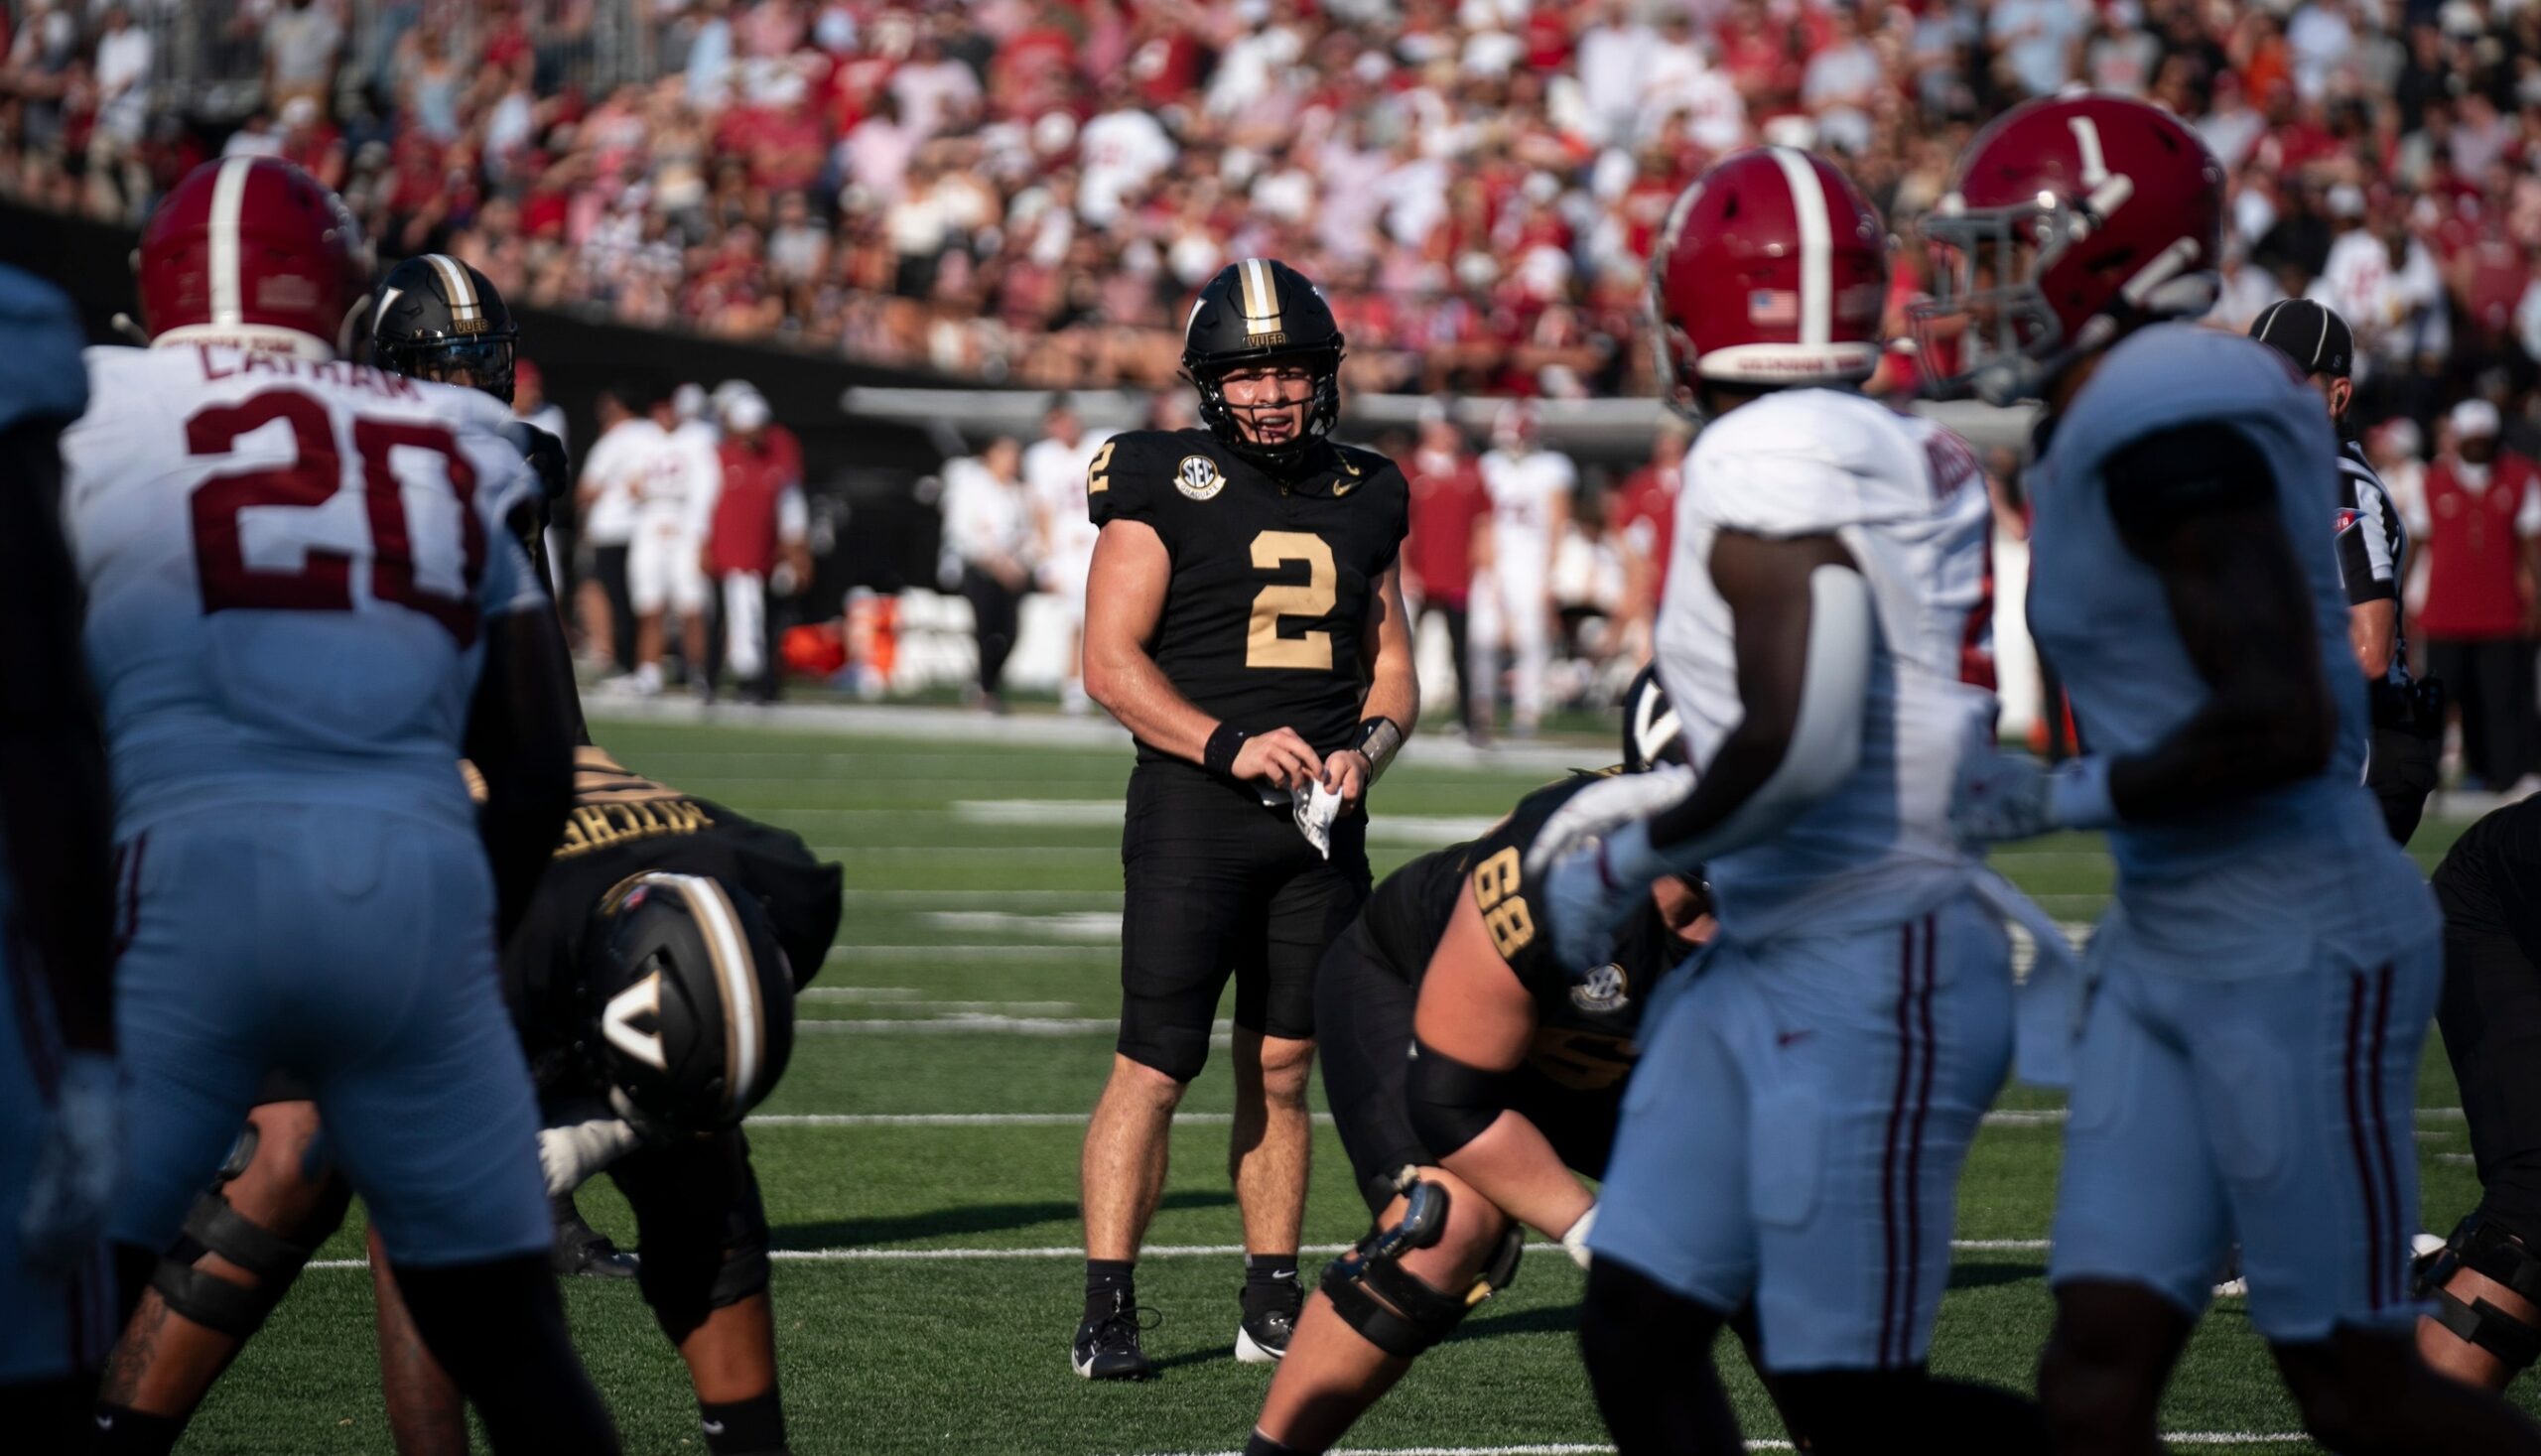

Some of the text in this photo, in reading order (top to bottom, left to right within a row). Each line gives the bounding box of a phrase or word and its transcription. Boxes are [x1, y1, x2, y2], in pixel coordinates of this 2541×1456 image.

[1247, 332, 1286, 347] VUFB
[1089, 442, 1116, 495] 2
[1182, 458, 1214, 487] SEC
[185, 385, 487, 654] 20
[1246, 530, 1337, 670] 2
[1473, 846, 1536, 959] 68
